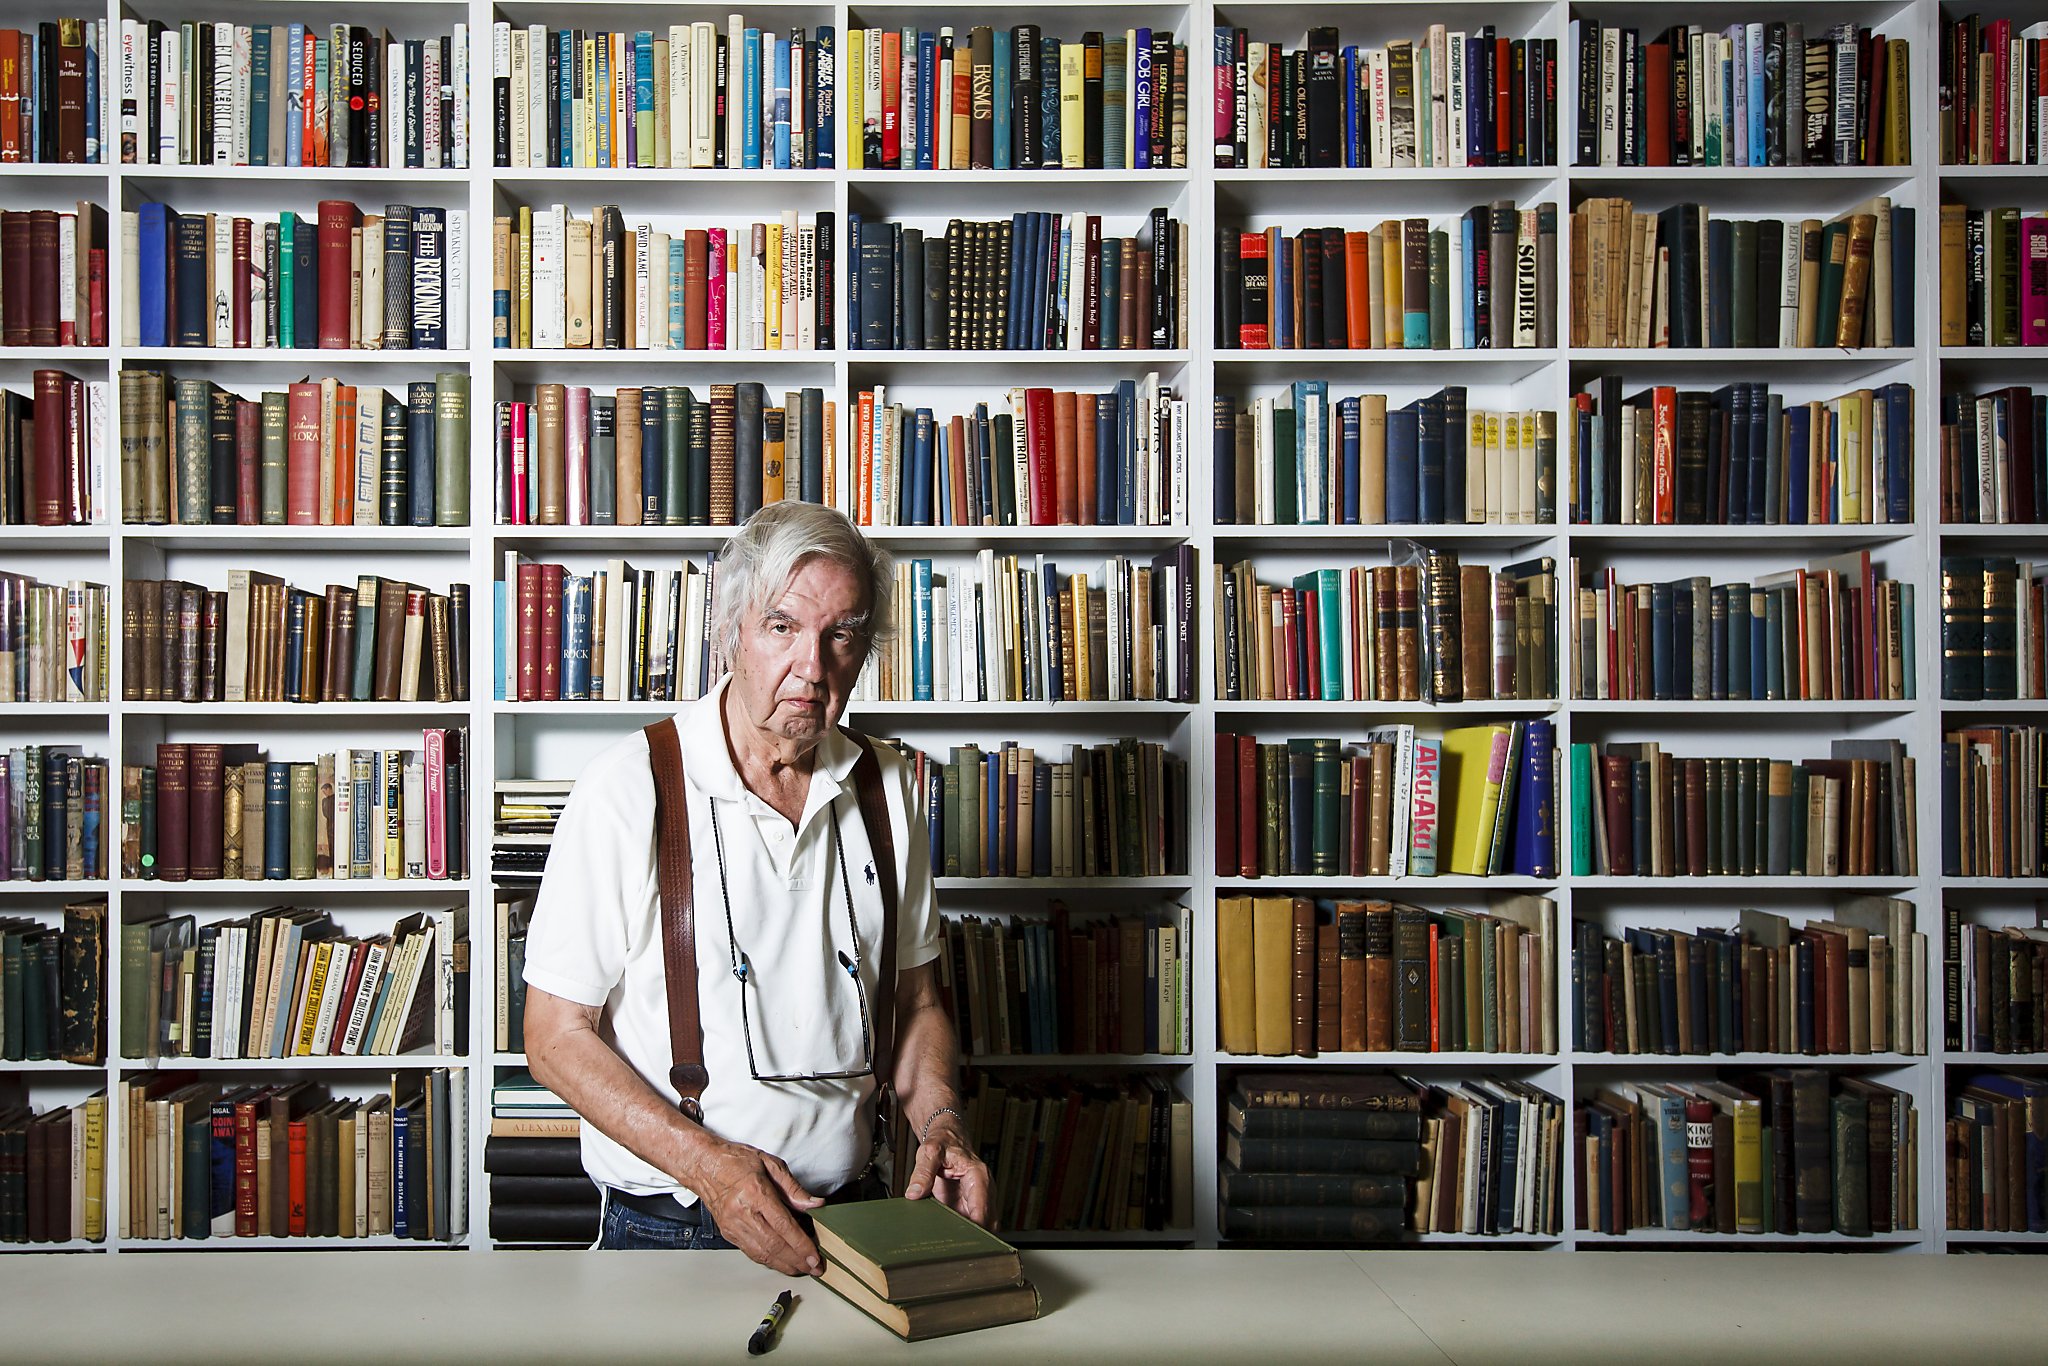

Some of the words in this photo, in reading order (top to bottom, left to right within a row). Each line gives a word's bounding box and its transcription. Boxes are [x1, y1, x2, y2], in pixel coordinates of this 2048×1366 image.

[1018, 28, 1030, 43] NEAL
[123, 36, 135, 94] eyewitness
[290, 28, 301, 85] BARMAN
[305, 41, 313, 65] PRESS
[352, 41, 363, 86] SEDUCED
[825, 54, 833, 74] HIGH
[1019, 44, 1031, 81] STEPHENSON
[1138, 48, 1151, 78] MOB
[1452, 36, 1461, 83] REDISCOVERING
[214, 46, 232, 97] ELAINE
[304, 66, 313, 89] GANG
[407, 72, 416, 88] The
[818, 48, 826, 87] AMERICA
[825, 75, 833, 85] IN
[1237, 62, 1246, 91] LAST
[1805, 41, 1828, 113] MEMO
[1839, 52, 1856, 102] HONOURABLE
[973, 64, 992, 119] ERASMUS
[1138, 82, 1150, 109] GIRL
[1376, 69, 1384, 96] MAN'S
[369, 97, 378, 108] 47
[407, 88, 416, 110] Book
[818, 90, 826, 127] Anderson
[1453, 85, 1462, 111] AMERICA
[214, 104, 232, 134] BILL
[1237, 95, 1246, 142] REFUGE
[1838, 103, 1855, 138] COMPANY
[452, 215, 461, 264] SPEAKING
[638, 225, 647, 247] DAVID
[1787, 225, 1799, 260] ELIOT'S
[1974, 218, 1983, 241] The
[420, 233, 435, 256] THE
[520, 235, 529, 300] LEISERSON
[638, 250, 647, 279] MAMET
[1787, 262, 1798, 282] NEW
[1974, 245, 1984, 282] Occult
[266, 268, 274, 289] upon
[452, 268, 461, 290] OUT
[1518, 245, 1535, 332] SOLDIER
[414, 257, 441, 330] RECKONING
[1478, 290, 1489, 306] REX
[1786, 285, 1796, 305] LIFE
[1980, 412, 1989, 441] LIVING
[883, 438, 892, 453] Way
[1981, 443, 1990, 466] WITH
[882, 463, 891, 502] Immortality
[1982, 468, 1992, 496] MAGIC
[429, 738, 439, 767] Marcel
[388, 763, 398, 788] PAUSE
[430, 767, 440, 792] Proust
[356, 784, 366, 797] THE
[1413, 744, 1437, 850] Aku-Aku
[357, 797, 367, 822] SERPENT
[388, 808, 398, 838] DESERT
[357, 830, 366, 842] THE
[357, 843, 367, 860] ROPE
[319, 947, 330, 961] JOHN
[371, 949, 383, 963] JOHN
[310, 962, 327, 995] BETJEMAN'S
[361, 965, 379, 997] BETJEMAN'S
[304, 998, 320, 1026] COLLECTED
[352, 998, 371, 1026] COLLECTED
[300, 1027, 314, 1045] POEMS
[346, 1027, 363, 1045] POEMS
[212, 1117, 235, 1127] GOIN
[1688, 1125, 1712, 1134] KING
